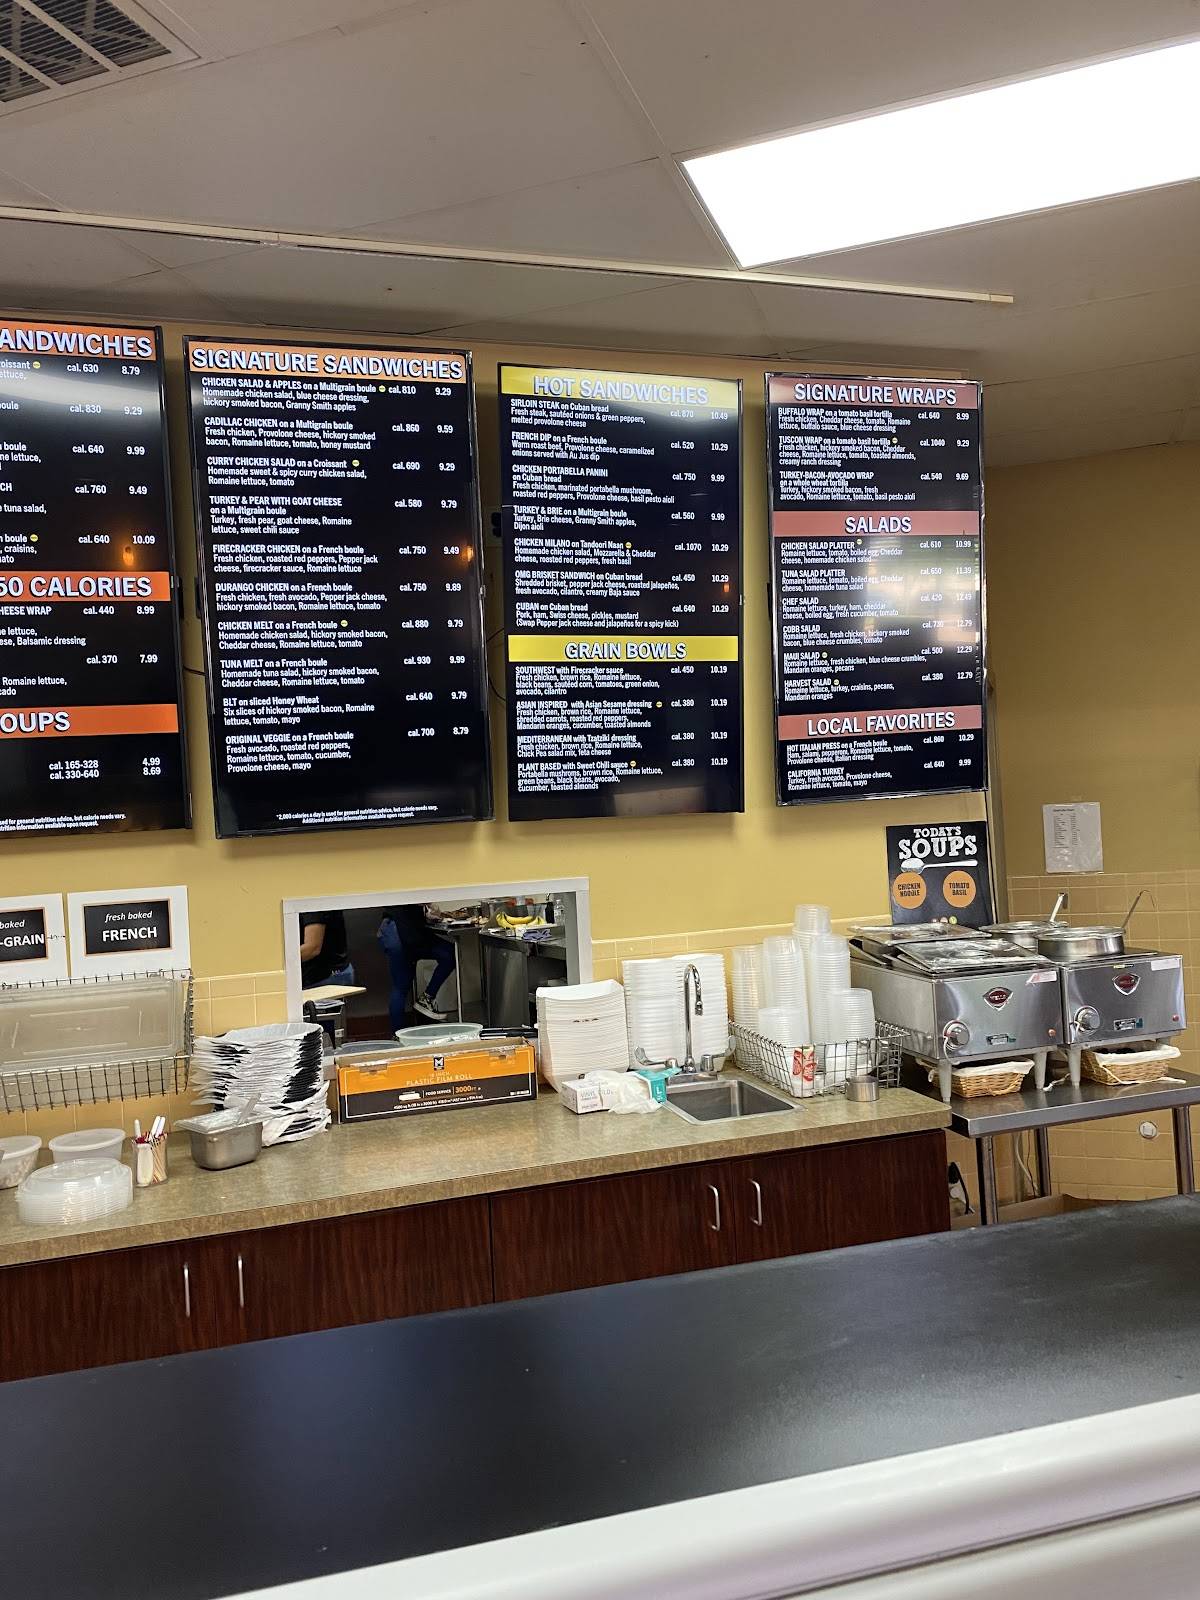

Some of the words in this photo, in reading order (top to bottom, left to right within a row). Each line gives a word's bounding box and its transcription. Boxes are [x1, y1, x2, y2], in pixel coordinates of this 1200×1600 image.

[121, 366, 140, 375] 8.79
[192, 350, 319, 372] SIGNATURE
[323, 355, 463, 378] SANDWICHES
[202, 377, 236, 387] CHICKEN
[238, 379, 263, 388] SALAD
[265, 380, 271, 388] &
[272, 380, 301, 390] APPLES
[319, 382, 354, 394] Multigrain
[356, 384, 376, 393] boule
[436, 387, 451, 396] 9.29
[534, 376, 575, 396] HOT
[579, 380, 708, 404] SANDWICHES
[794, 384, 893, 403] SIGNATURE
[897, 387, 956, 404] WRAPS
[124, 406, 142, 415] 9.29
[511, 399, 537, 408] SIRLOIN
[538, 400, 559, 410] STEAK
[570, 402, 589, 411] Cuban
[590, 403, 608, 412] bread
[205, 417, 242, 427] CADILLAC
[243, 418, 277, 428] CHICKEN
[296, 420, 331, 431] Multigrain
[333, 421, 353, 430] boule
[437, 425, 453, 434] 9.59
[4, 442, 26, 451] boule
[126, 446, 145, 455] 9.99
[512, 465, 541, 474] CHICKEN
[543, 466, 584, 475] PORTABELLA
[586, 467, 608, 476] PANINI
[129, 486, 147, 495] 9.49
[209, 496, 239, 505] TURKEY
[241, 496, 247, 505] &
[249, 496, 269, 505] PEAR
[270, 497, 290, 505] WITH
[292, 497, 311, 506] GOAT
[313, 497, 342, 506] CHEESE
[441, 500, 457, 509] 9.79
[845, 517, 911, 532] SALADS
[5, 534, 27, 542] boule
[132, 536, 155, 544] 10.09
[30, 576, 151, 596] CALORIES
[26, 606, 52, 615] WRAP
[137, 606, 154, 614] 8.99
[218, 621, 252, 630] CHICKEN
[253, 621, 273, 629] MELT
[291, 620, 316, 629] French
[317, 620, 337, 629] boule
[448, 619, 463, 628] 9.79
[17, 636, 52, 646] Balsamic
[53, 636, 86, 647] dressing
[565, 643, 620, 659] GRAIN
[626, 642, 687, 658] BOWLS
[140, 655, 157, 663] 7.99
[3, 676, 36, 685] Romaine
[37, 676, 67, 686] lettuce,
[223, 697, 236, 706] BLT
[249, 697, 270, 705] sliced
[272, 696, 294, 707] Honey
[296, 696, 319, 704] Wheat
[451, 691, 467, 700] 9.79
[808, 717, 862, 736] LOCAL
[866, 711, 954, 732] FAVORITES
[142, 758, 160, 766] 4.99
[143, 767, 161, 776] 8.69
[914, 826, 961, 838] TODAY'S
[899, 836, 977, 859] SOUPS
[105, 913, 125, 923] fresh
[128, 911, 152, 919] baked
[103, 927, 157, 941] FRENCH
